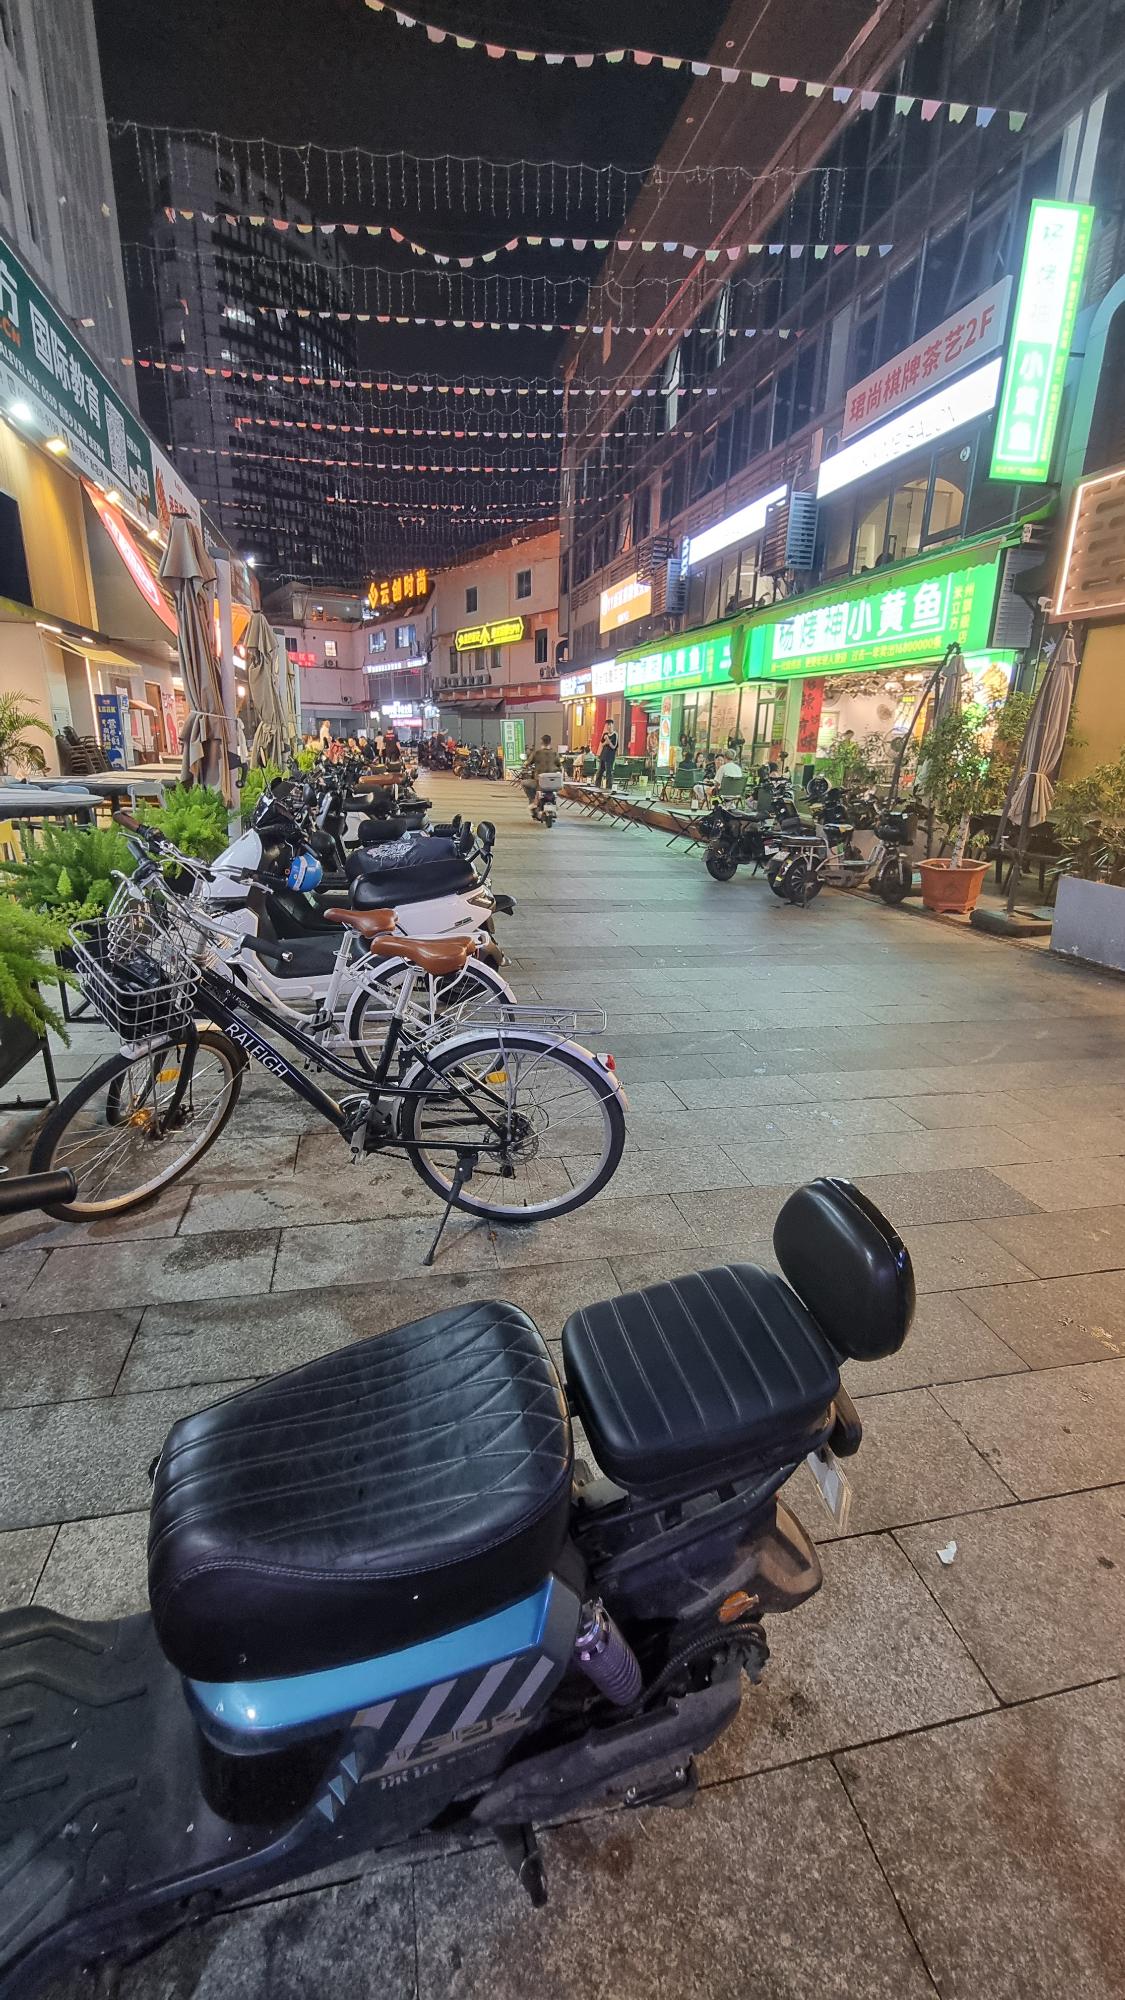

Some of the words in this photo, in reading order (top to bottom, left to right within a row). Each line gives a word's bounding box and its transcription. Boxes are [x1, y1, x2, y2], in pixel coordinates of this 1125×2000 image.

[29, 300, 101, 430] 国际教育
[379, 569, 428, 605] 云创时尚
[225, 1022, 290, 1078] RALEIGH
